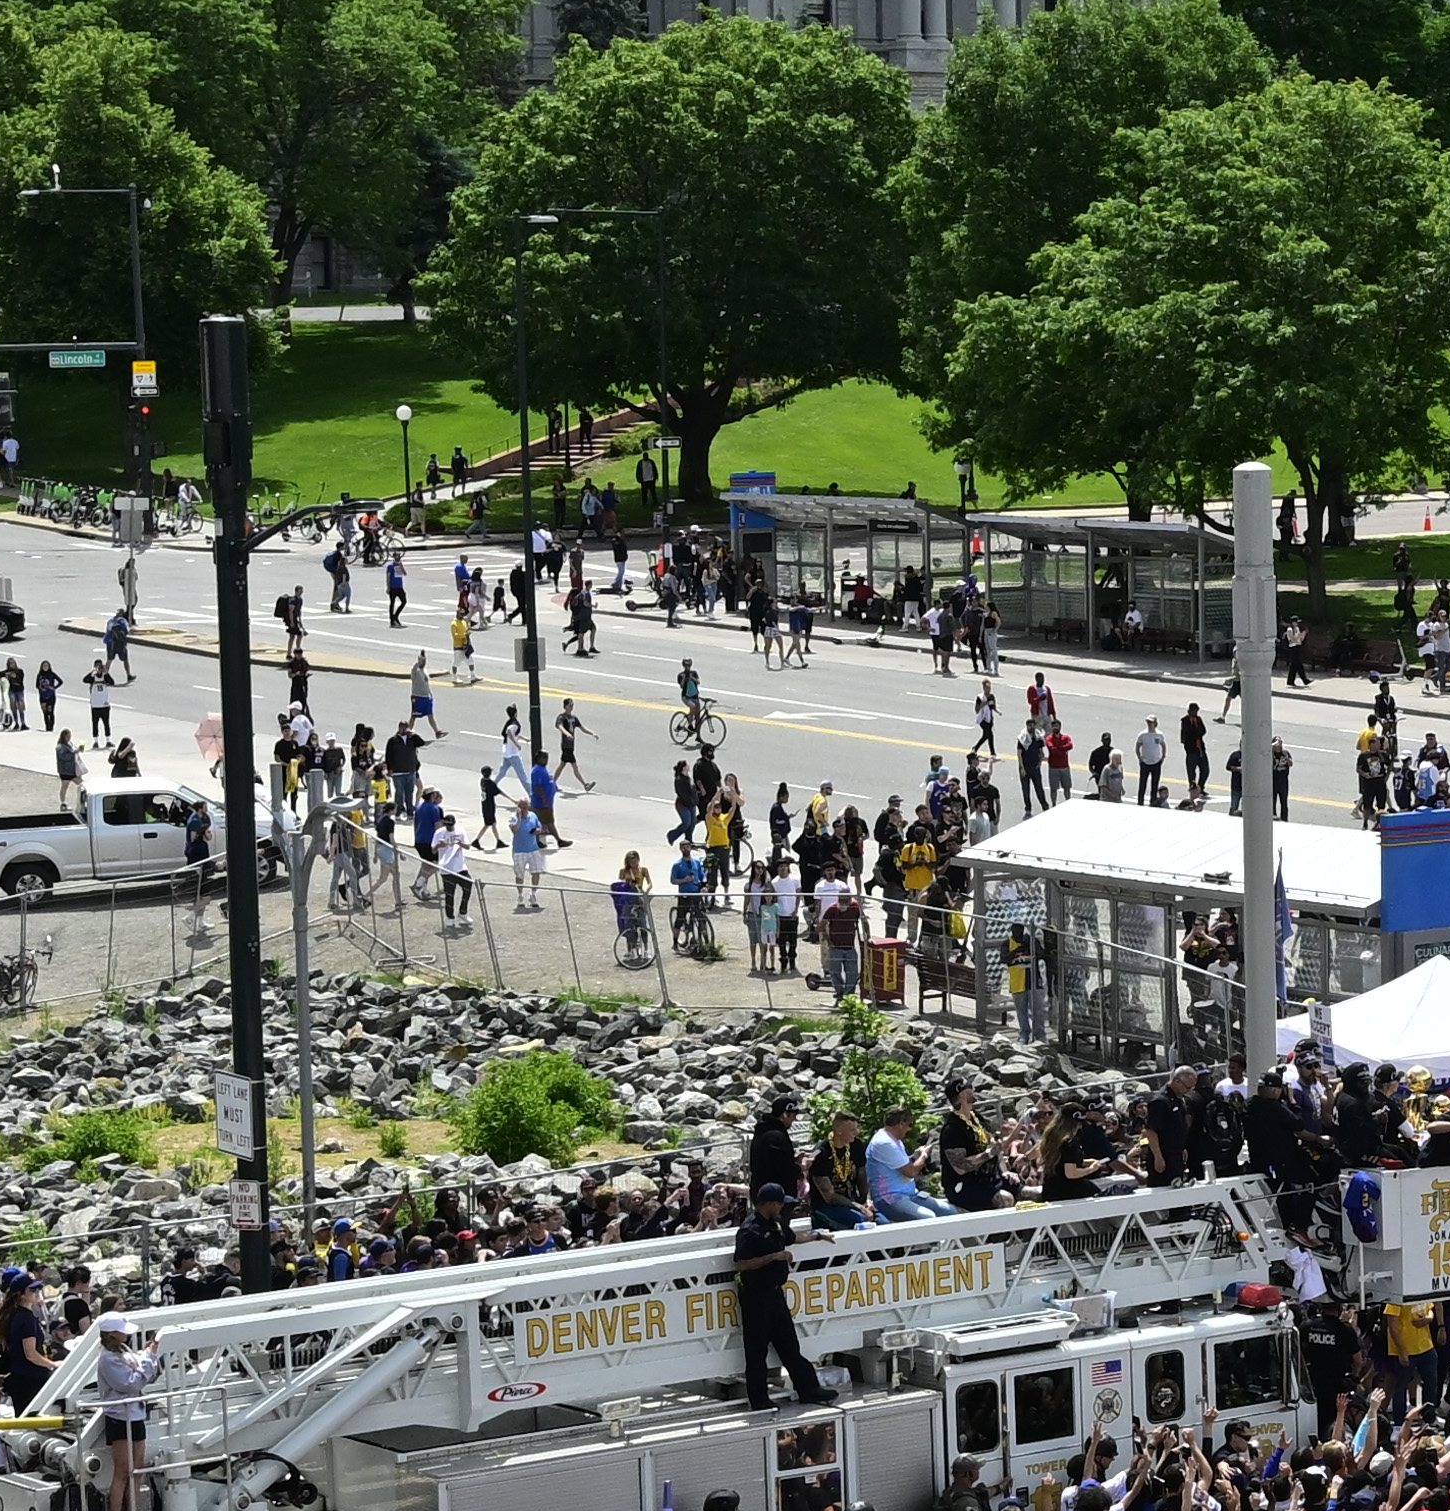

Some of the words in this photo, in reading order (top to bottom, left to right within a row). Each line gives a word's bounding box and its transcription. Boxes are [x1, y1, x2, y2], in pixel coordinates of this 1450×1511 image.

[59, 353, 92, 366] Lincoln
[217, 1081, 233, 1099] LEFT
[223, 1104, 244, 1125] MUST
[218, 1133, 234, 1150] TURN
[236, 1132, 251, 1150] LEFT
[238, 1183, 250, 1193] NO
[232, 1194, 258, 1205] PARKING
[525, 1300, 668, 1359] DENVER
[685, 1293, 741, 1341] FIR
[784, 1251, 995, 1321] DEPARTMENT
[1308, 1333, 1336, 1345] POLICE
[501, 1386, 533, 1397] Pierce
[1249, 1422, 1284, 1436] ENVER
[1024, 1458, 1067, 1476] TOWER
